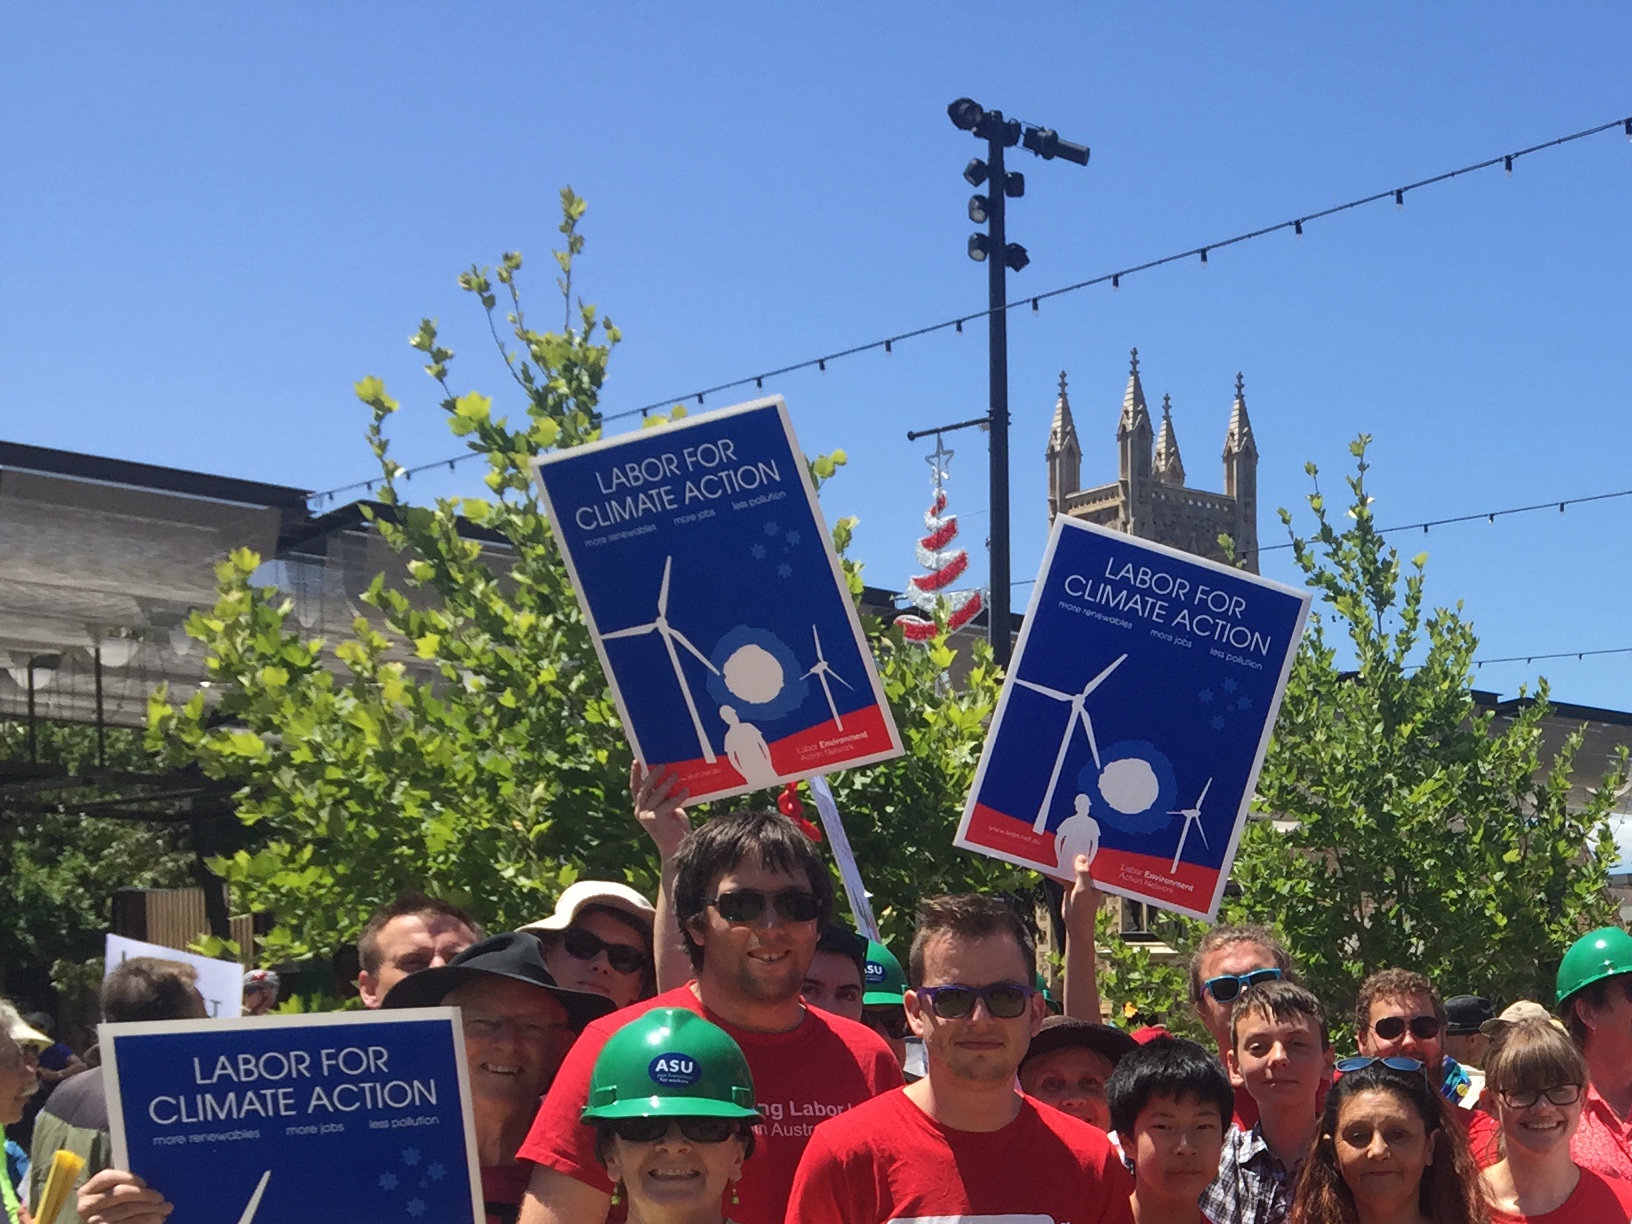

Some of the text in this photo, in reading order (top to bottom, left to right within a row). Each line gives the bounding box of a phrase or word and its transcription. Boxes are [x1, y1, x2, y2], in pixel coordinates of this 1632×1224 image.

[574, 458, 780, 531] CLIMATE ACTION
[594, 438, 737, 495] LABOR FOR
[1063, 574, 1271, 656] CLIMATE ACTION
[1104, 556, 1246, 619] LABOR FOR
[1057, 600, 1263, 670] more renewables more jobs less pollution
[193, 1045, 389, 1085] LABOR FOR
[655, 1059, 694, 1074] ASU
[148, 1078, 437, 1125] CLIMATE ACTION
[152, 1134, 186, 1146] more
[285, 1124, 318, 1136] more
[319, 1121, 344, 1135] jobs
[367, 1119, 389, 1130] less
